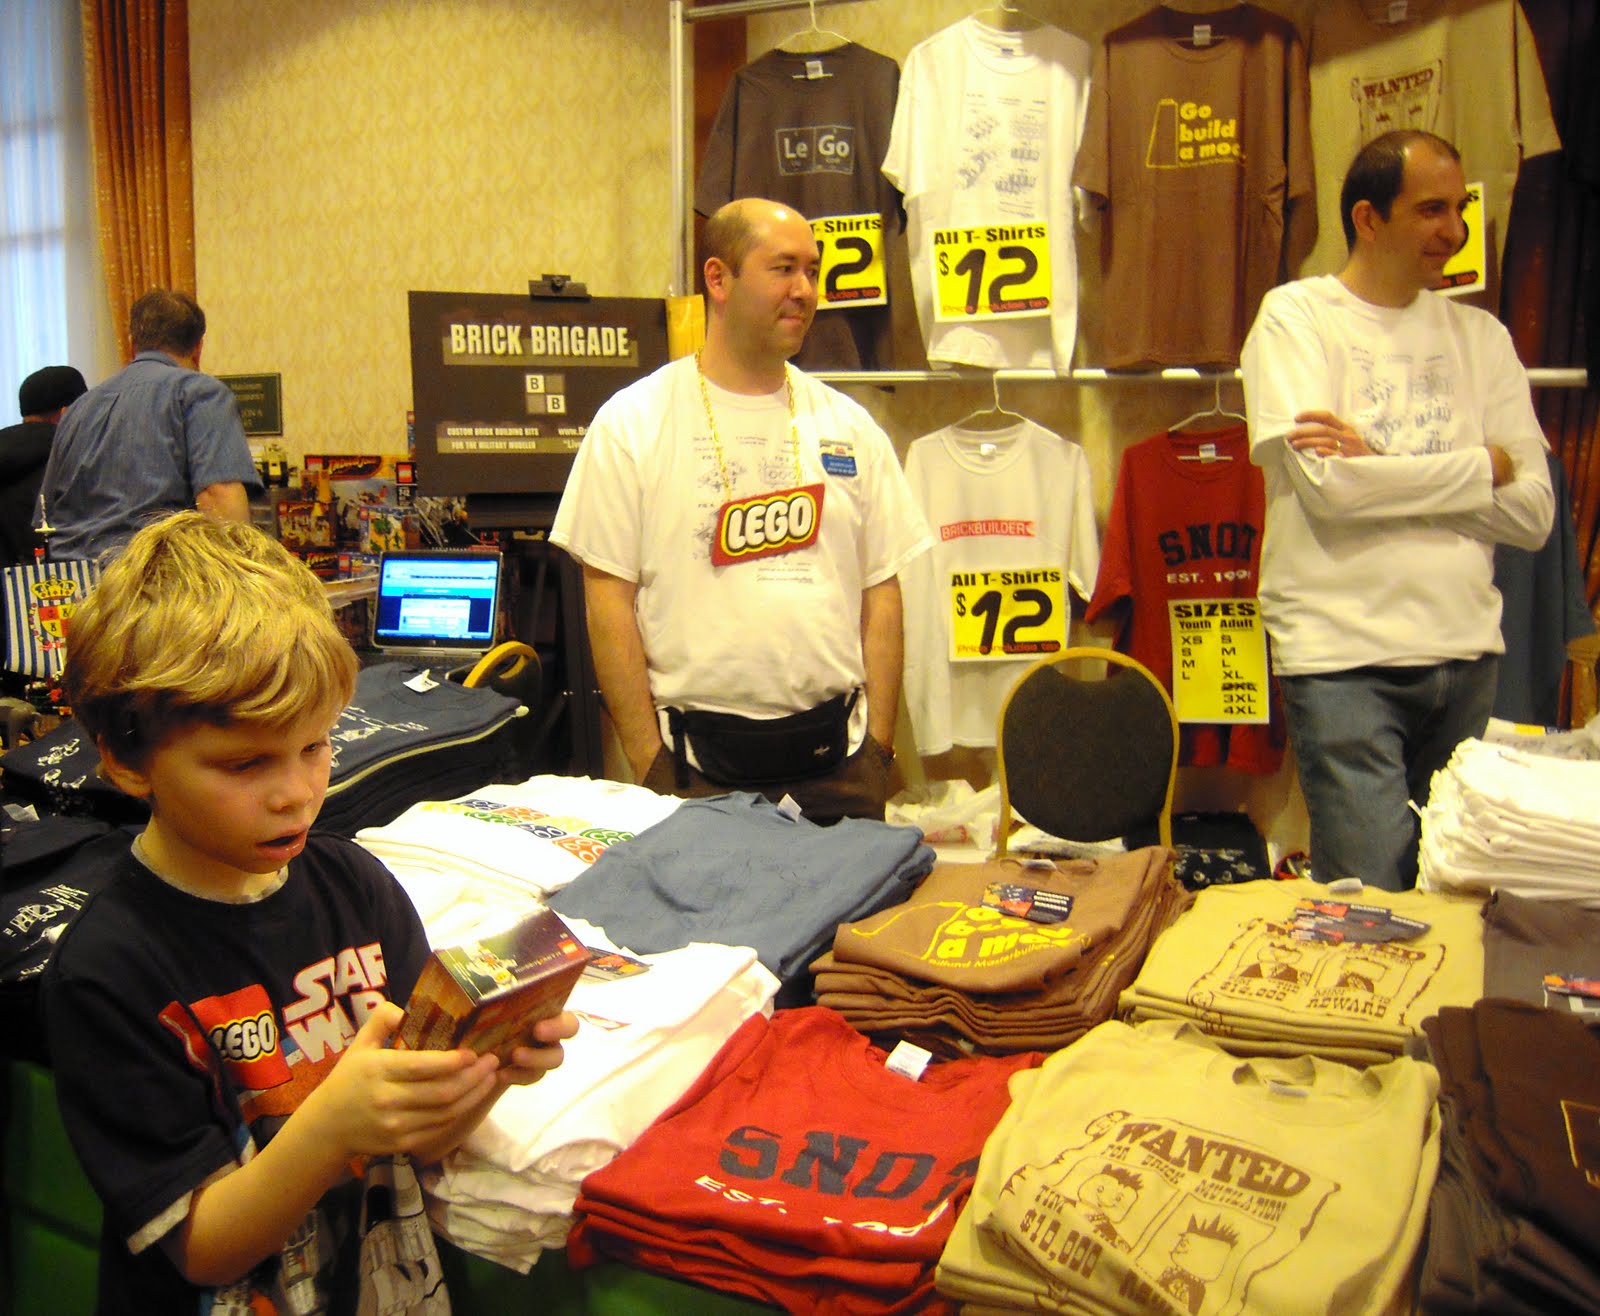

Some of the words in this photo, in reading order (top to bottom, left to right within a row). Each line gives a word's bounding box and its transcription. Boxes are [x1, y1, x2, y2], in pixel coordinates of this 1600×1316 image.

[1363, 69, 1434, 100] WANTED
[1180, 102, 1212, 120] Go
[1179, 119, 1236, 142] build
[783, 137, 808, 159] Le
[818, 134, 850, 158] Go
[1179, 146, 1194, 160] a
[824, 218, 881, 233] Shirts
[934, 231, 959, 246] All
[986, 226, 1046, 242] Shirts
[450, 323, 524, 355] BRICK
[530, 325, 631, 357] BRIGADE
[726, 494, 814, 552] LEGO
[941, 520, 1026, 540] BRICKBUILDER
[951, 573, 977, 587] All
[1001, 571, 1061, 586] Shirts
[1166, 572, 1205, 584] EST.
[1174, 602, 1257, 618] SIZES
[1179, 619, 1212, 630] Youth
[1220, 618, 1253, 629] Adult
[1180, 635, 1203, 646] XS
[1220, 633, 1232, 645] S
[1181, 646, 1192, 657] S
[1221, 646, 1236, 656] M
[1181, 659, 1195, 669] M
[1222, 658, 1231, 668] L
[1182, 671, 1190, 681] L
[1223, 670, 1244, 680] XL
[1223, 693, 1257, 704] 3XL
[1223, 705, 1257, 716] 4XL
[937, 938, 967, 959] a
[1115, 1122, 1311, 1198] WANTED
[1101, 1143, 1131, 1162] FOR
[1141, 1153, 1186, 1185] BRICK
[1194, 1179, 1288, 1222] MUTILATION
[1019, 1207, 1104, 1280] $10,000
